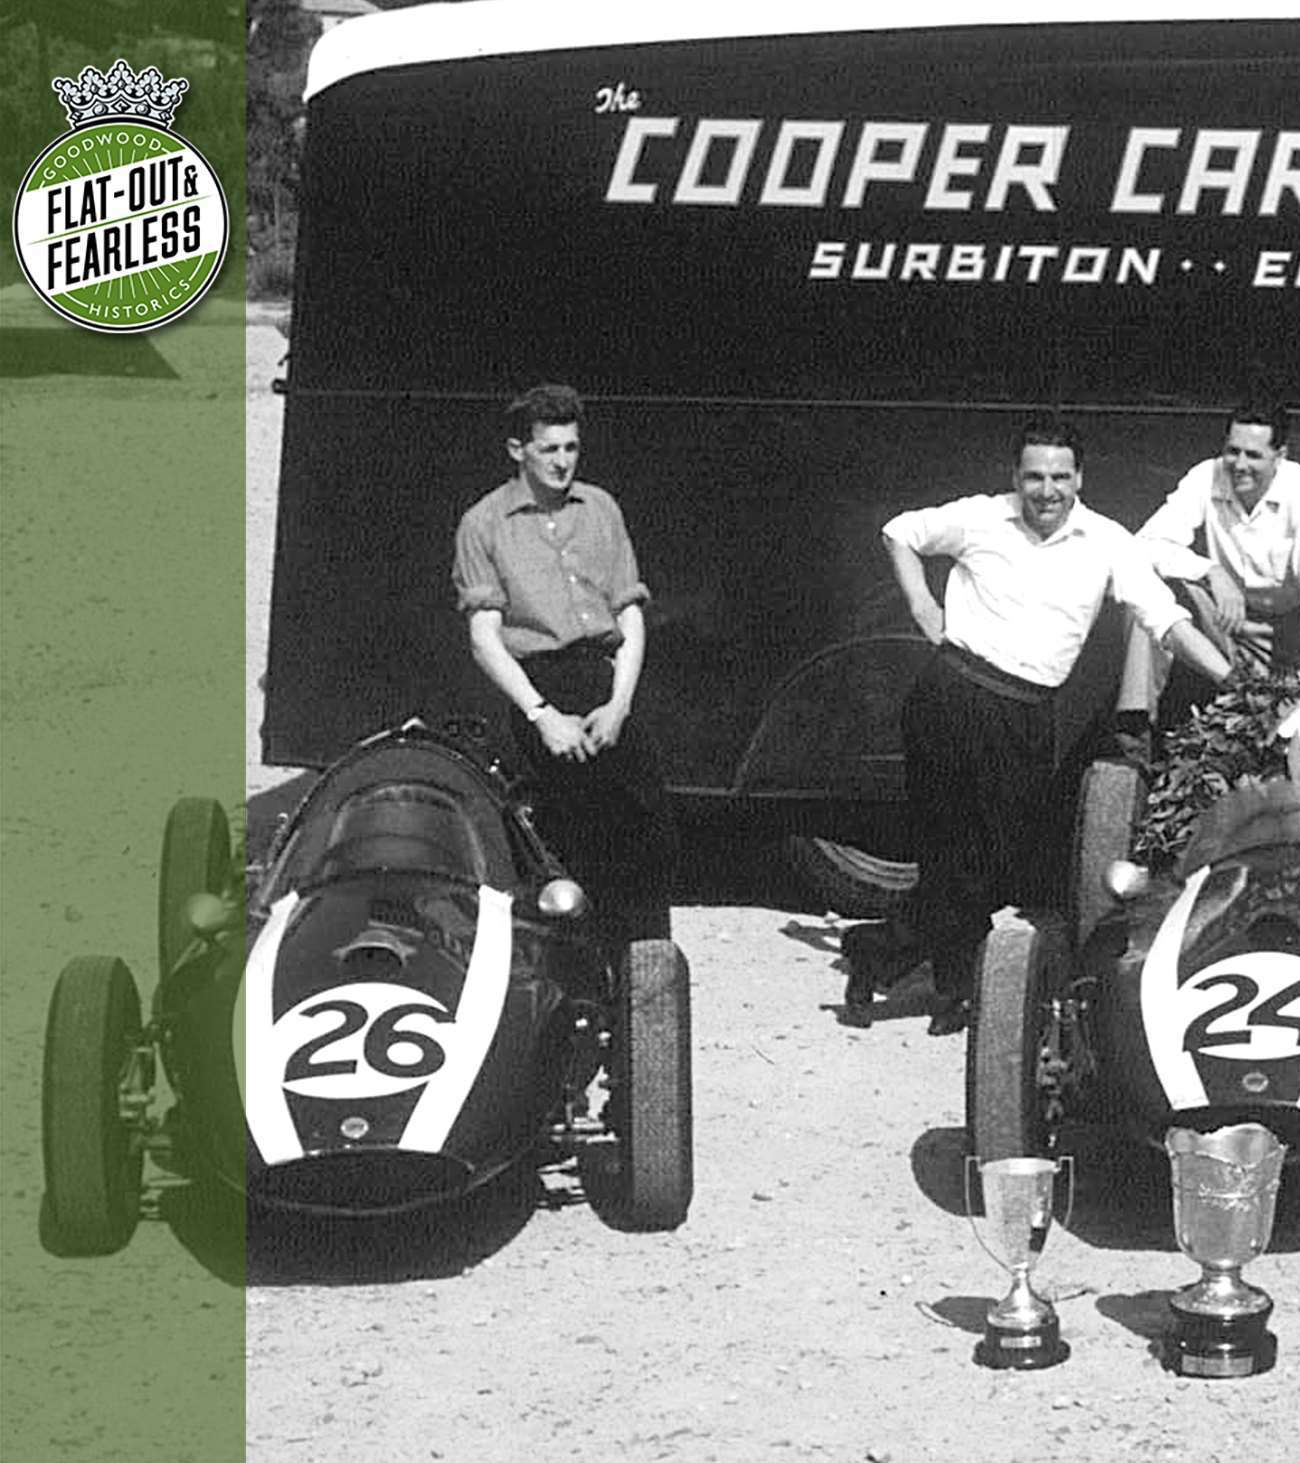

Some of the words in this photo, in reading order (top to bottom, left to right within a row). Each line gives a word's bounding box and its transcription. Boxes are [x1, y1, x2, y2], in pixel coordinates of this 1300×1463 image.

[594, 82, 641, 113] The
[605, 116, 1071, 211] COOPER
[809, 242, 1161, 285] SURBITON
[283, 999, 456, 1083] 26
